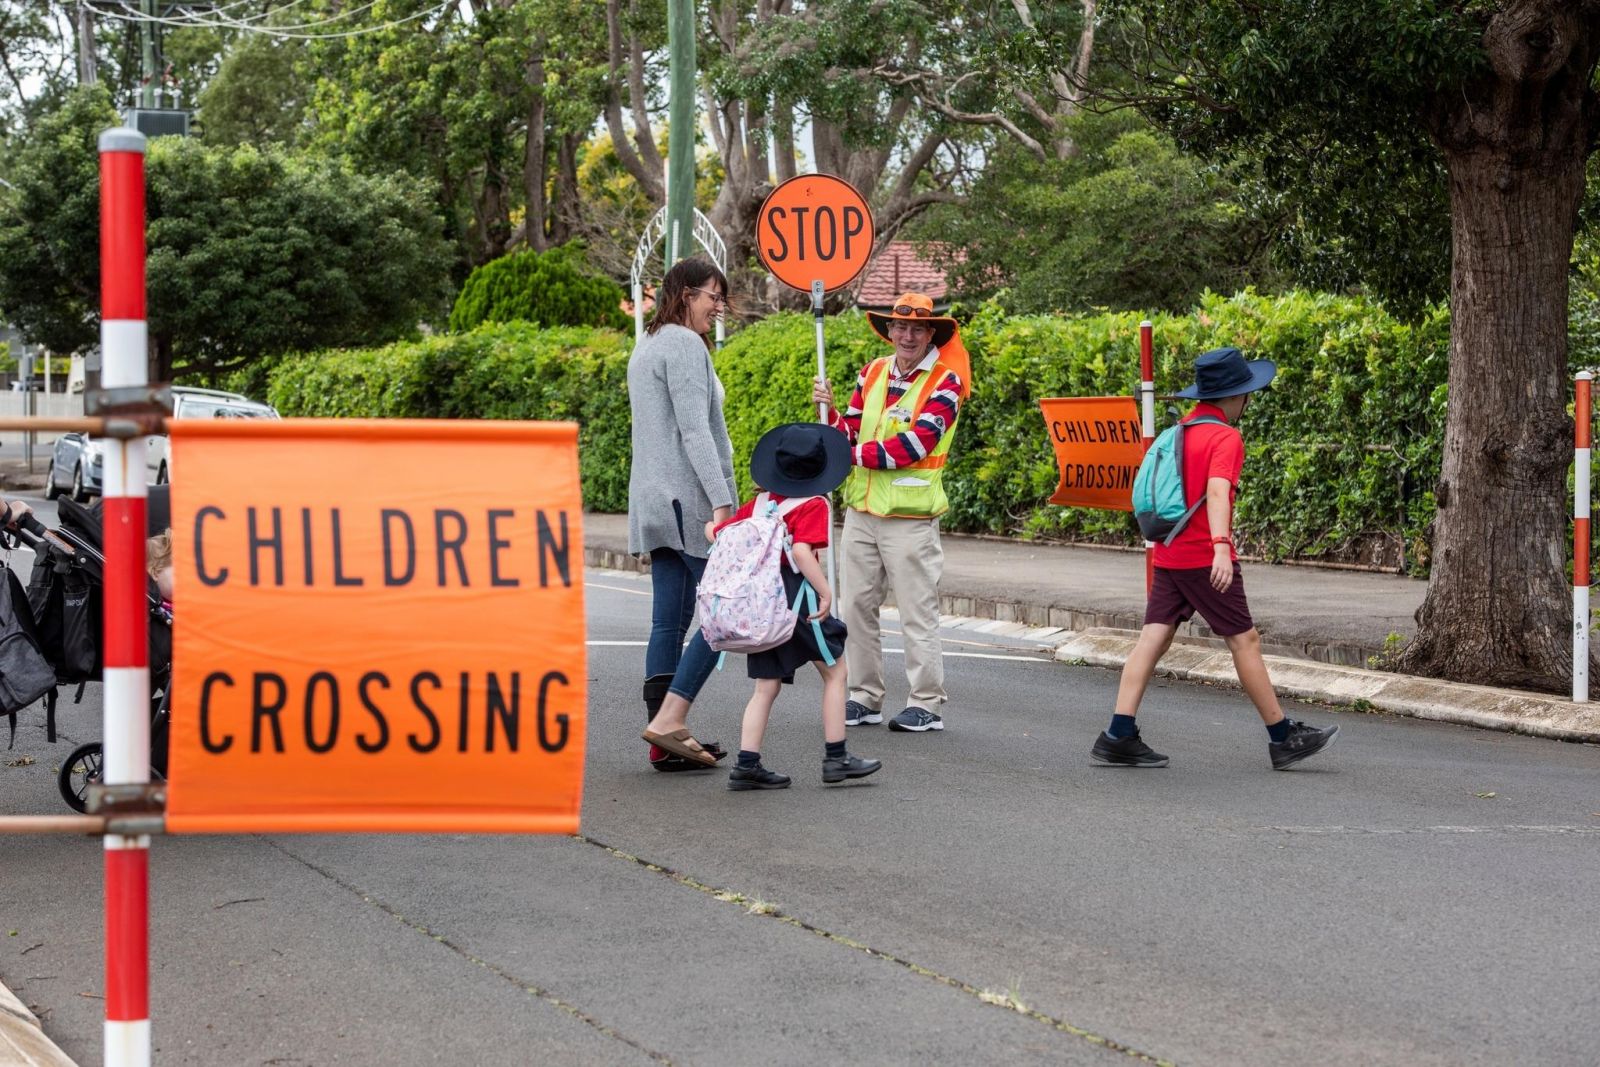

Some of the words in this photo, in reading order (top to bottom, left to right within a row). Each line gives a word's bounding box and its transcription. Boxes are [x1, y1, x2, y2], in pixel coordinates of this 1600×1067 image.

[768, 206, 865, 262] STOP
[1052, 420, 1141, 444] CHILDREN
[195, 506, 571, 587] CHILDREN
[200, 672, 569, 754] CROSSING
